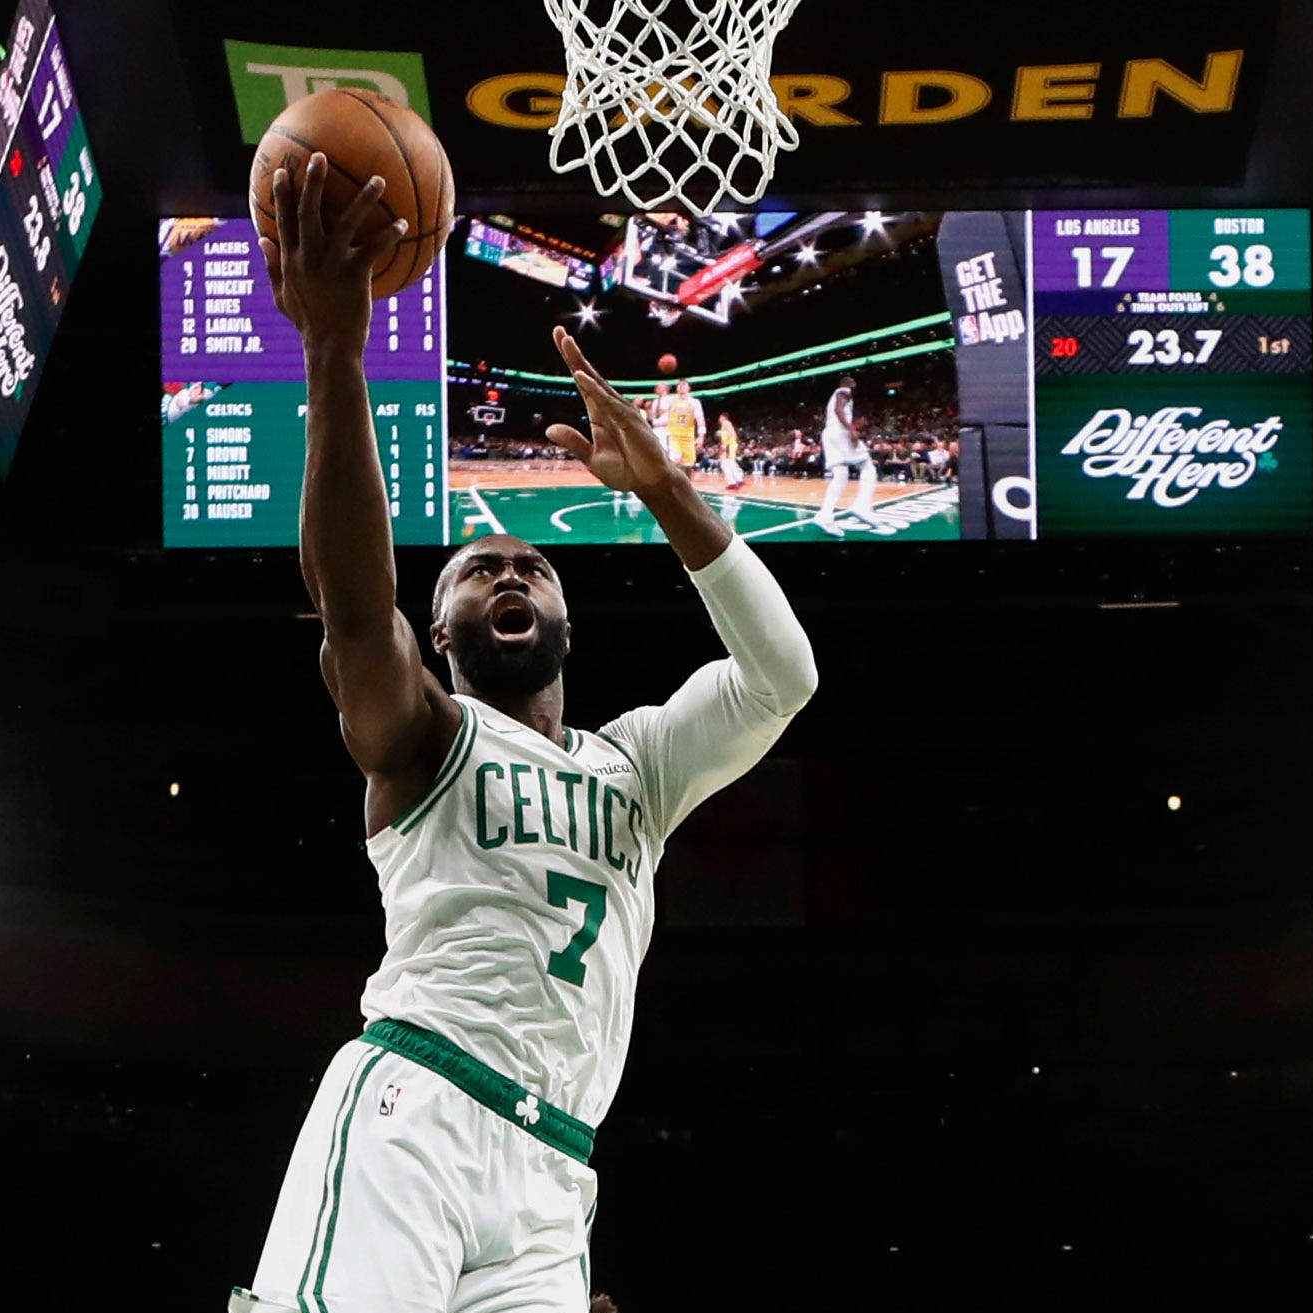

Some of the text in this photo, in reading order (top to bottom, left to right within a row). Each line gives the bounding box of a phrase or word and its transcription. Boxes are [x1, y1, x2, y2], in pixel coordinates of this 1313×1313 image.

[466, 48, 1244, 130] GARDEN
[1056, 219, 1140, 236] LOS ANGELES
[1214, 218, 1265, 234] BOSTON
[204, 242, 250, 254] LAKERS
[955, 251, 996, 288] GET
[1072, 247, 1135, 288] 17
[1208, 245, 1275, 287] 38
[960, 277, 1007, 313] THE
[1138, 292, 1167, 302] TEAM
[1169, 292, 1202, 302] FOULS
[424, 315, 432, 331] 1
[979, 308, 1025, 344] App
[205, 336, 243, 353] SMITH
[244, 337, 264, 353] JR.
[1051, 330, 1290, 365] 20 23.7 1st
[206, 404, 436, 417] CELTICS AST FLS
[206, 427, 251, 443] SIMONS
[1061, 406, 1283, 462] Different
[207, 484, 271, 500] PRITCHARD
[1083, 452, 1256, 508] Here
[208, 503, 252, 519] HAUSER
[475, 761, 643, 889] CELTICS
[546, 869, 607, 988] 7
